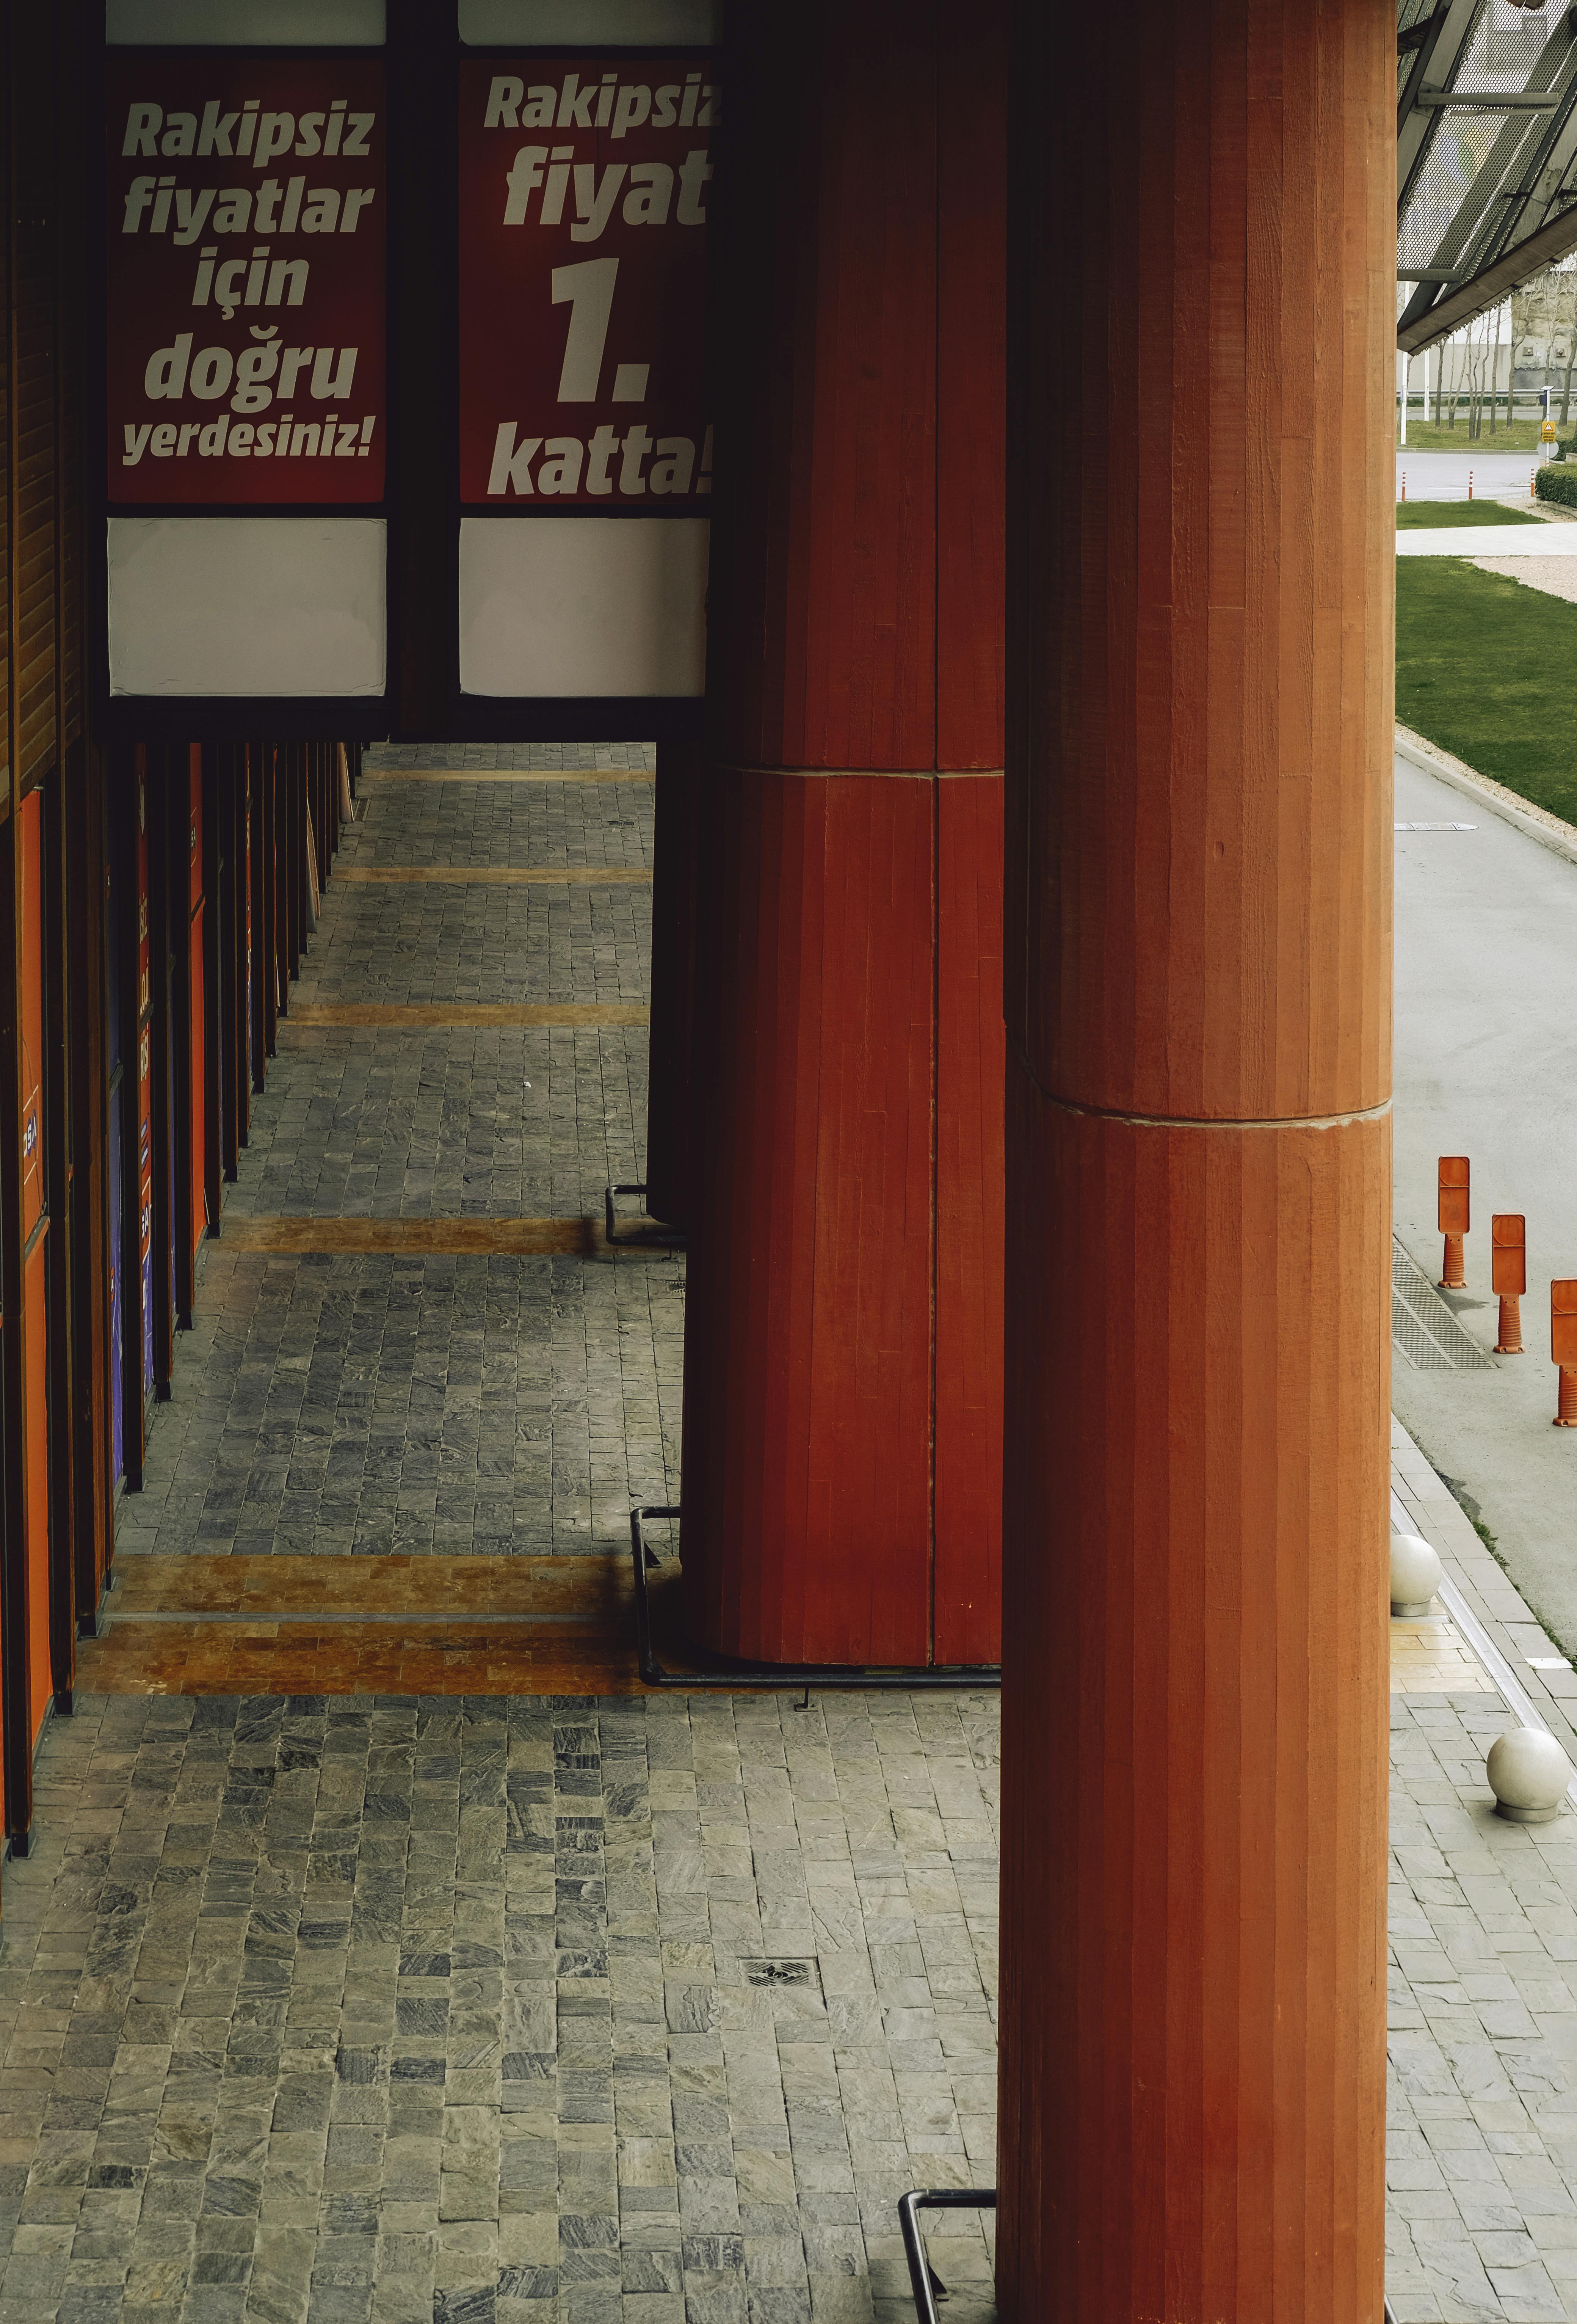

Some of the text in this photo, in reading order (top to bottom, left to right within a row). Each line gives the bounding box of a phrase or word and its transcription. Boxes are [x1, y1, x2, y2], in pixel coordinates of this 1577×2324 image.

[122, 99, 375, 168] Rakipsiz
[484, 73, 722, 139] Rakipsiz
[122, 176, 375, 245] fiyatlar
[503, 146, 714, 242] fiyat
[192, 246, 309, 320] için
[552, 258, 650, 402] 1.
[145, 325, 358, 413] doğru
[123, 414, 376, 466] yerdesiniz!
[487, 422, 713, 495] katta!
